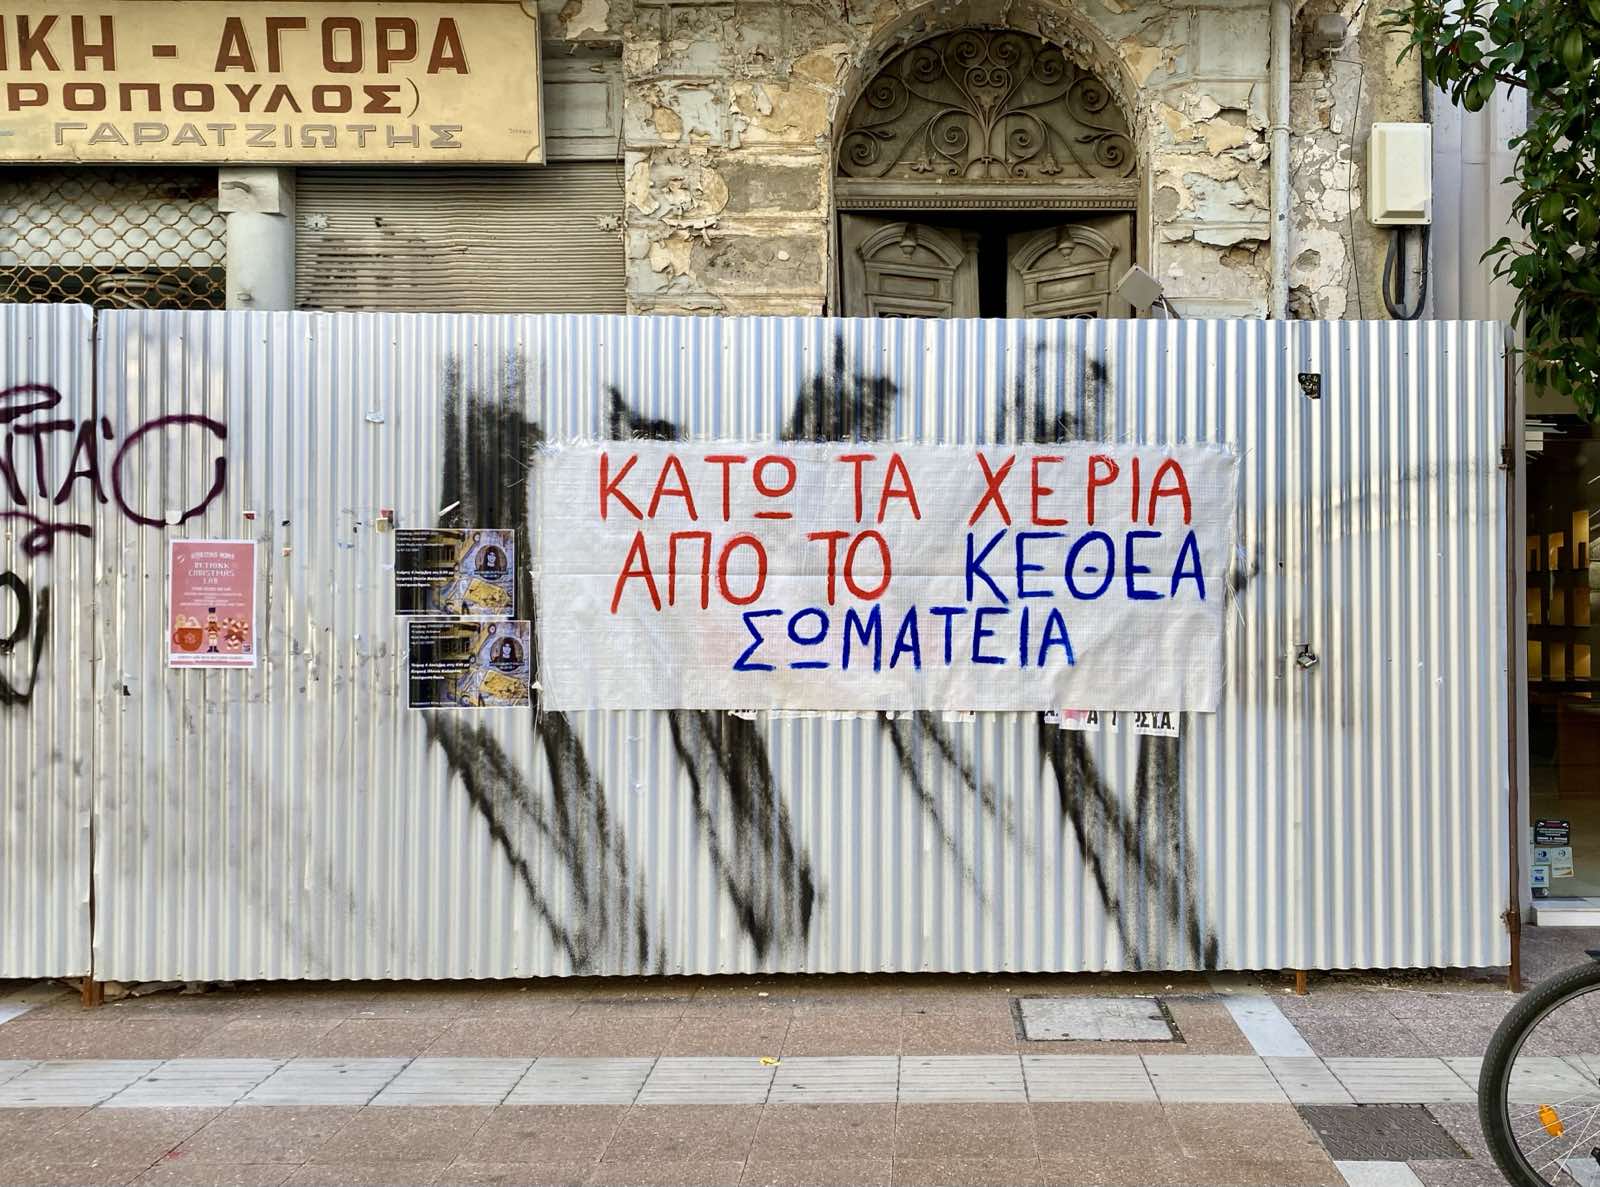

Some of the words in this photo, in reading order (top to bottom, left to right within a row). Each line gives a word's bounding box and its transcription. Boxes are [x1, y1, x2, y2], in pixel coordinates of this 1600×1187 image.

[215, 16, 470, 75] ΑΓΟΡΑ
[54, 122, 463, 149] ΓΑΡΑΤΖΙΩΤΗΣ
[599, 452, 797, 521] ΚΑΤΩ
[837, 453, 921, 524] ΤΑ
[968, 453, 1192, 527] ΧΕΡΙΑ
[610, 530, 768, 615] ΑΠΟ
[806, 530, 892, 606] ΤΟ
[965, 528, 1206, 606] ΚΕΘΕΑ
[733, 604, 1076, 673] ΣΩΜΑΤΕΙΑ
